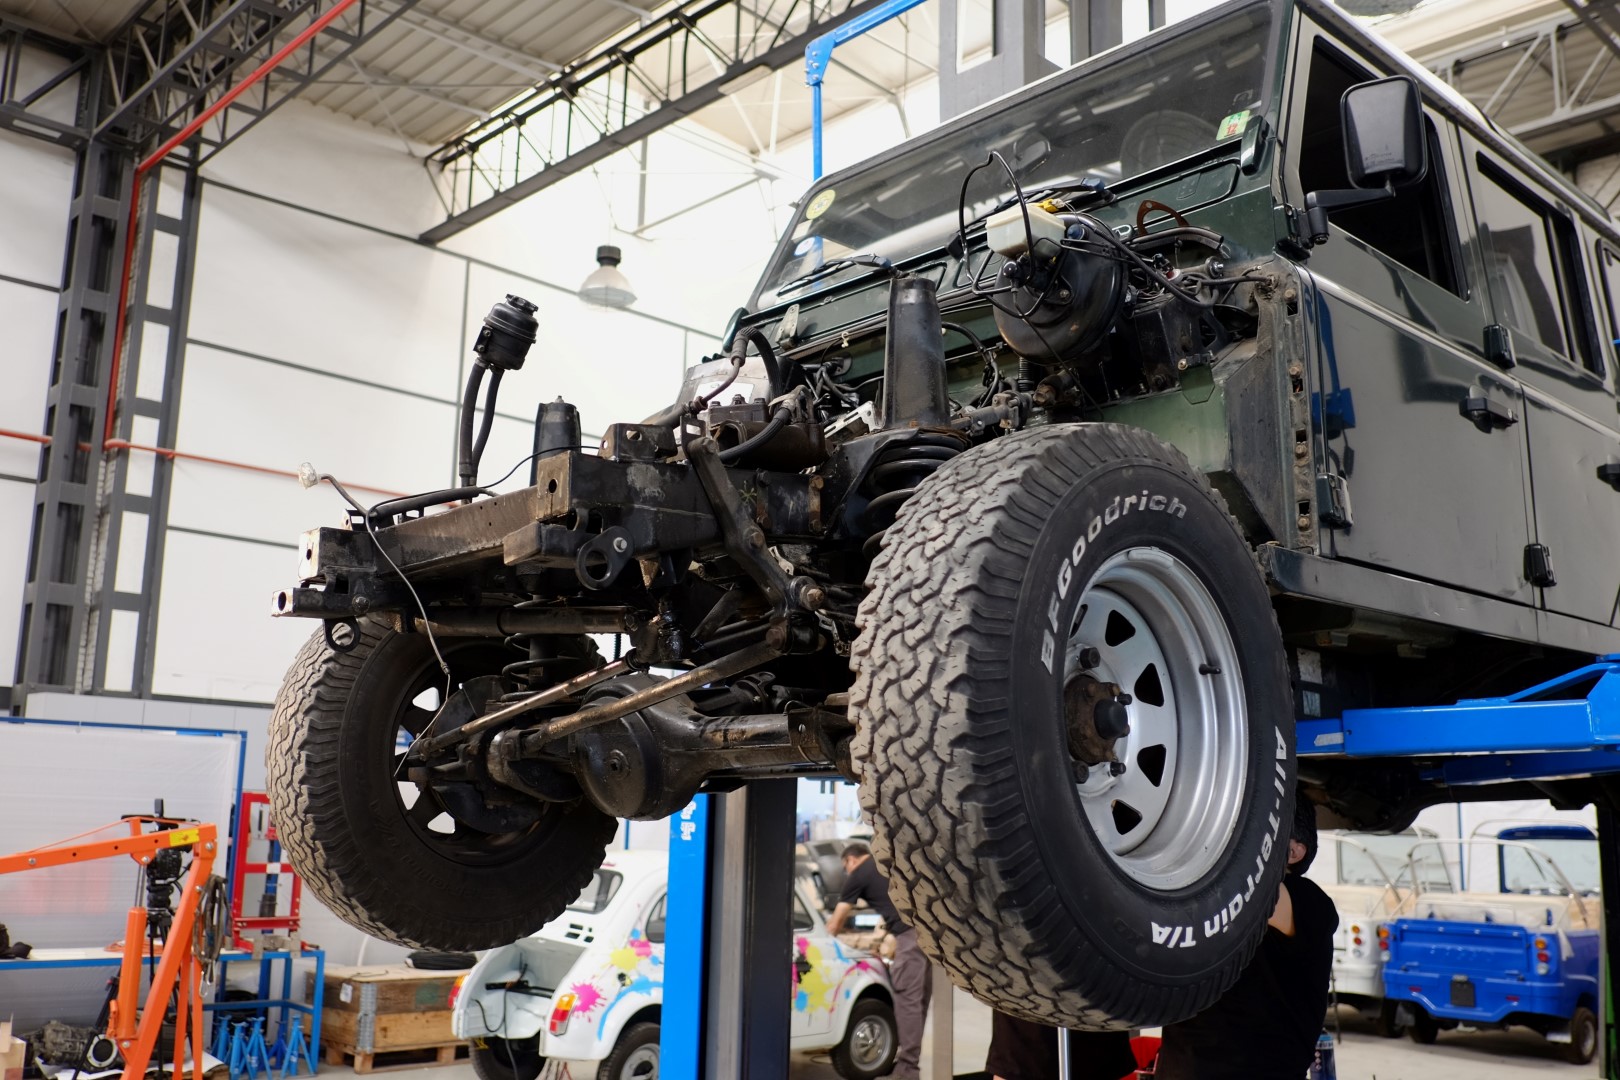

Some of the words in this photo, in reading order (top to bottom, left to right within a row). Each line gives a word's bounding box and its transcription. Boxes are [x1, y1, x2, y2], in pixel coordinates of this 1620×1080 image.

[1041, 490, 1188, 675] BFGoodrich
[1204, 726, 1287, 938] All-Terrain
[1150, 921, 1197, 949] T/A
